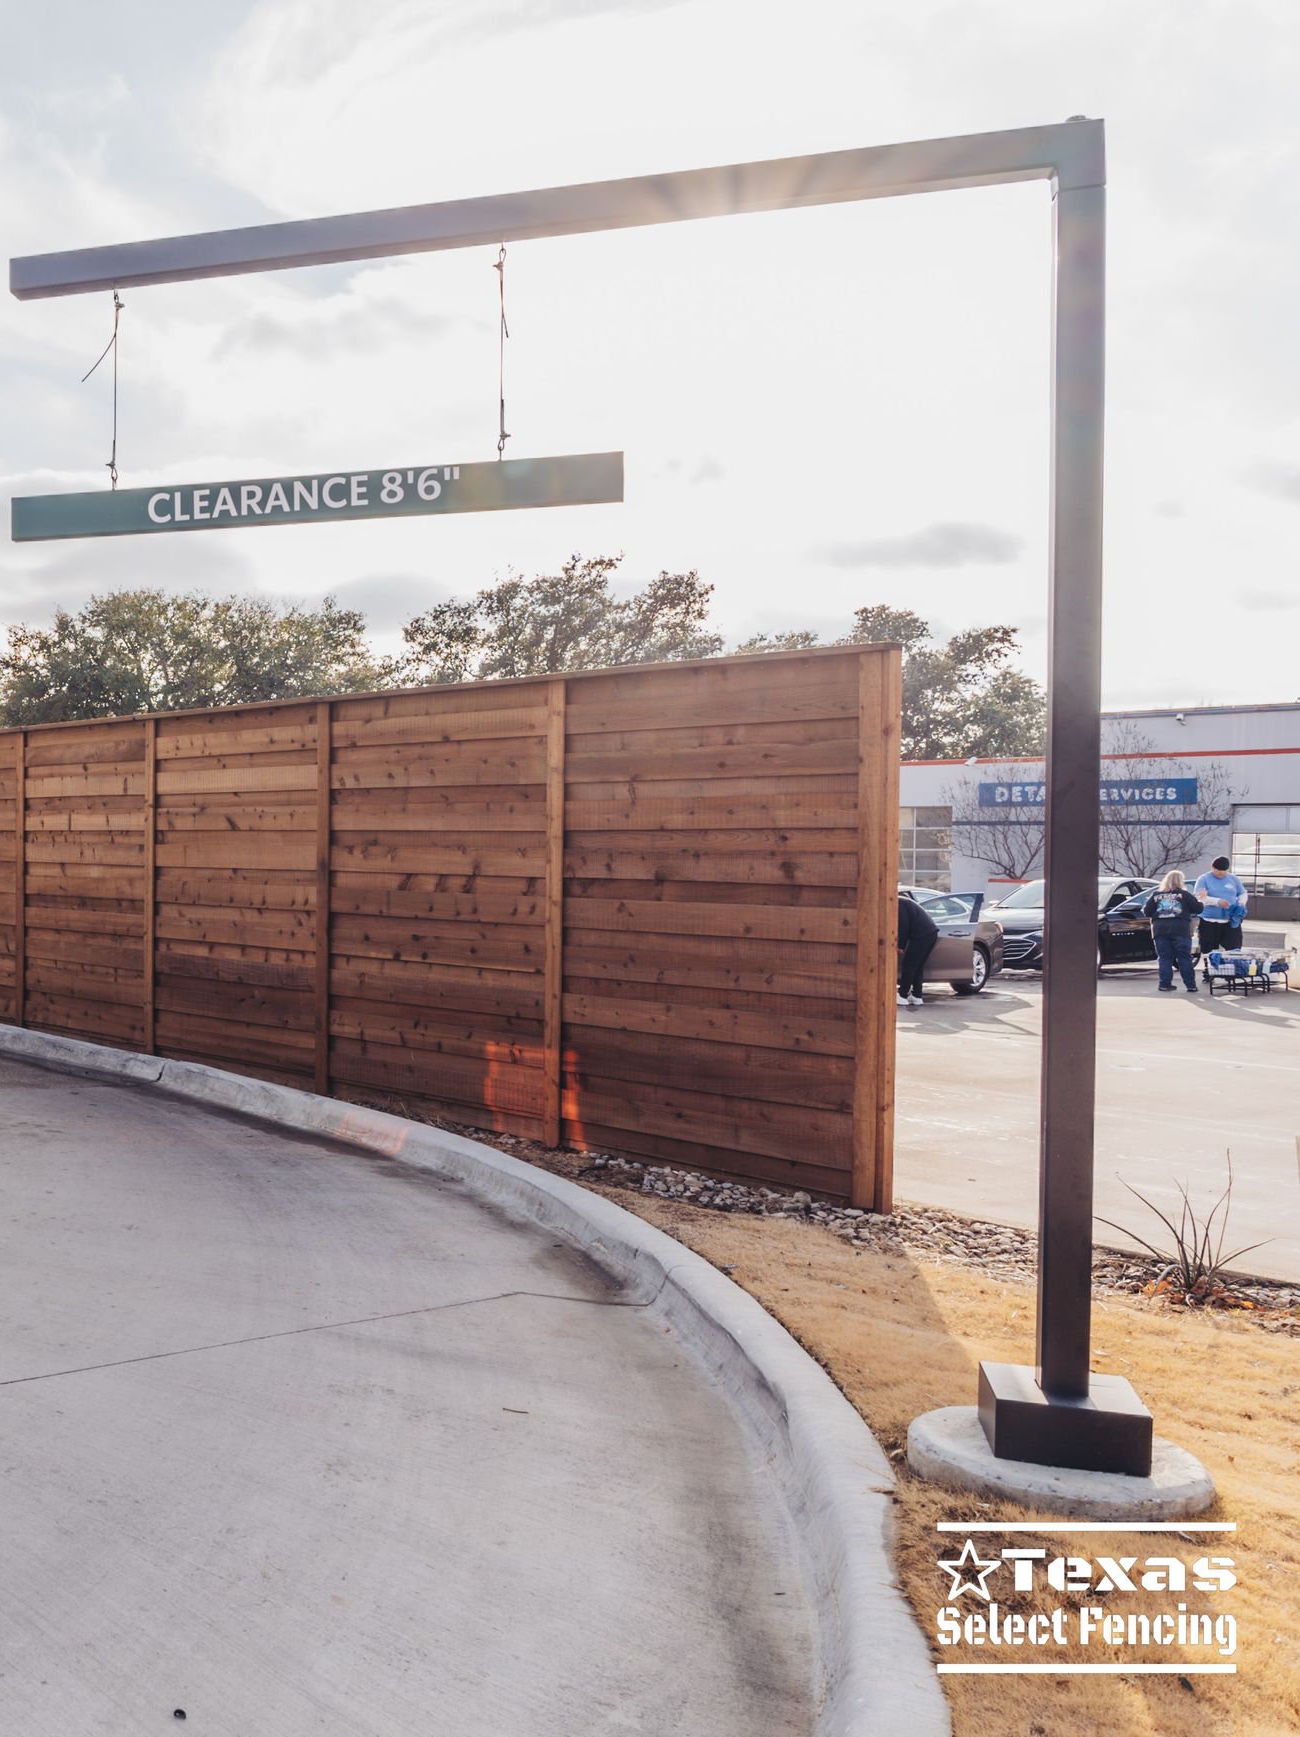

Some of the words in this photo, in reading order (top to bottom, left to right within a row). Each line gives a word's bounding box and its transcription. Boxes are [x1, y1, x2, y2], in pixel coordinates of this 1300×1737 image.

[147, 475, 369, 524] CLEARANCE
[380, 466, 461, 503] 8'6"
[995, 785, 1046, 802] DETA
[1099, 787, 1177, 801] ERVICES
